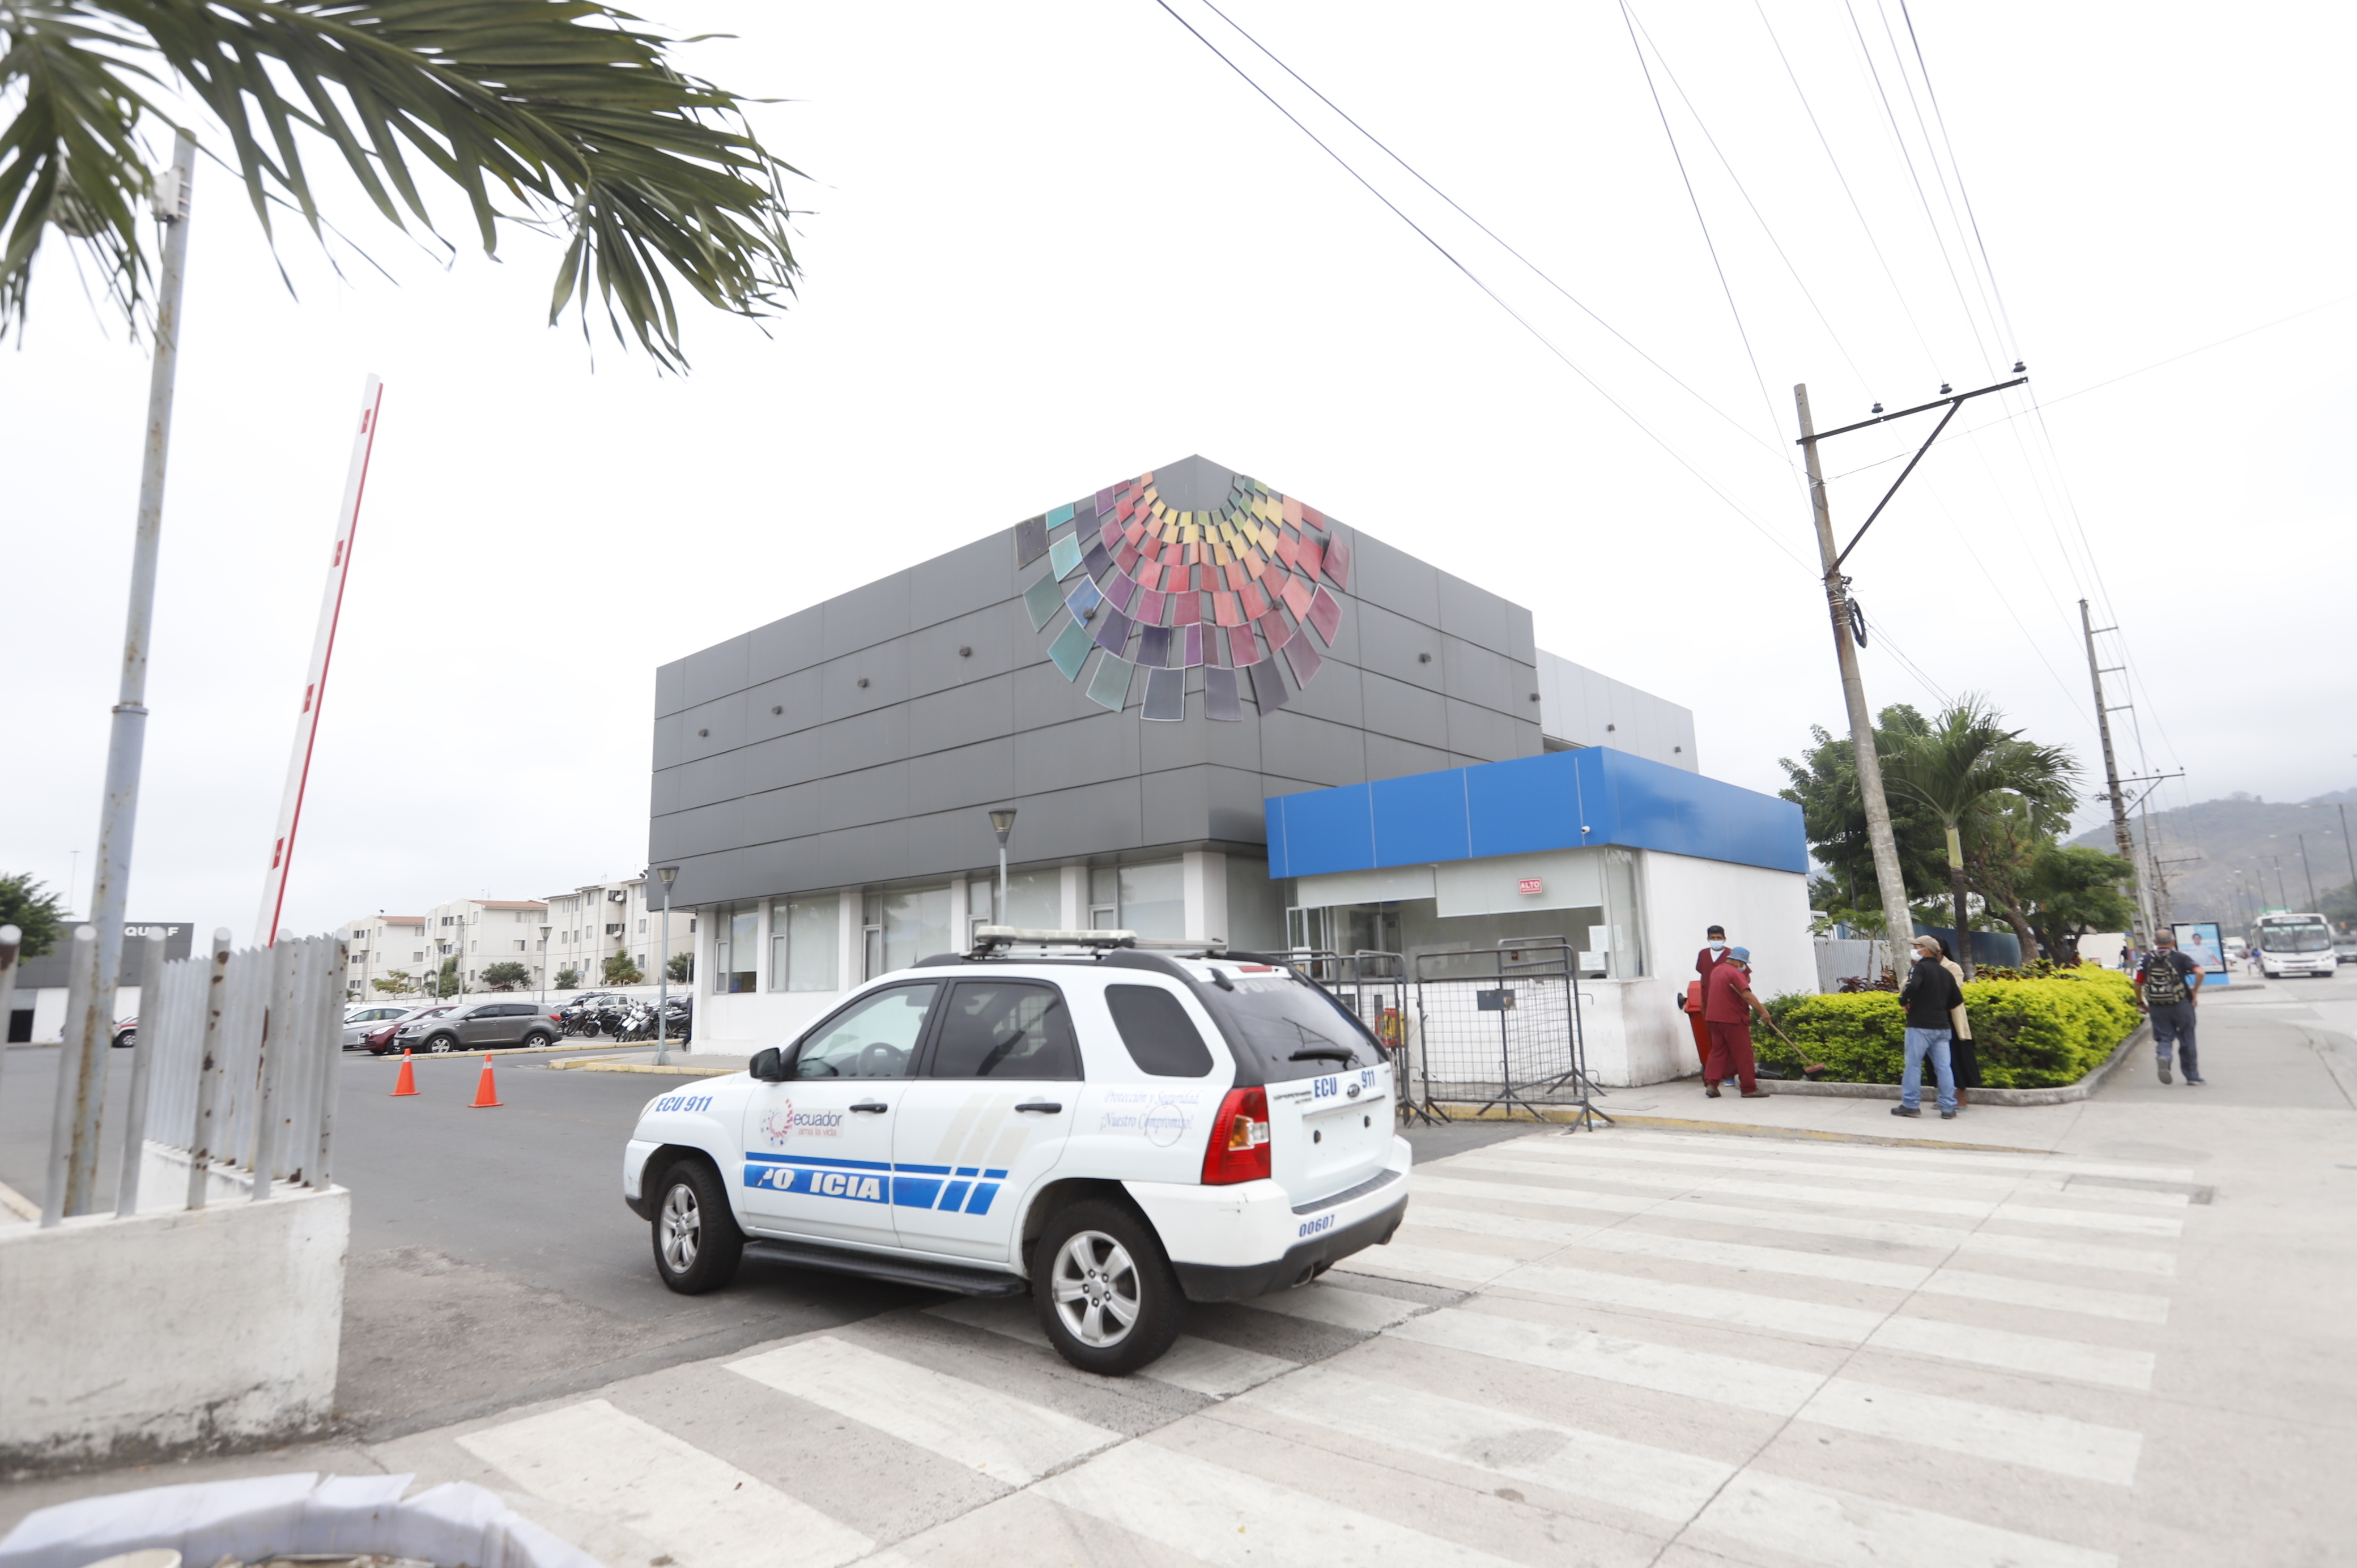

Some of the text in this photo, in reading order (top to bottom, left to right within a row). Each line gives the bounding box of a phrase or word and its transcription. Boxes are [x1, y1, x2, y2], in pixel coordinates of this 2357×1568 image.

[1314, 1077, 1337, 1098] ECU
[1361, 1070, 1375, 1088] 911
[655, 1096, 713, 1112] ECU 911
[794, 1111, 843, 1127] ecuador
[823, 1128, 837, 1136] vida
[1299, 1215, 1335, 1237] 00607
